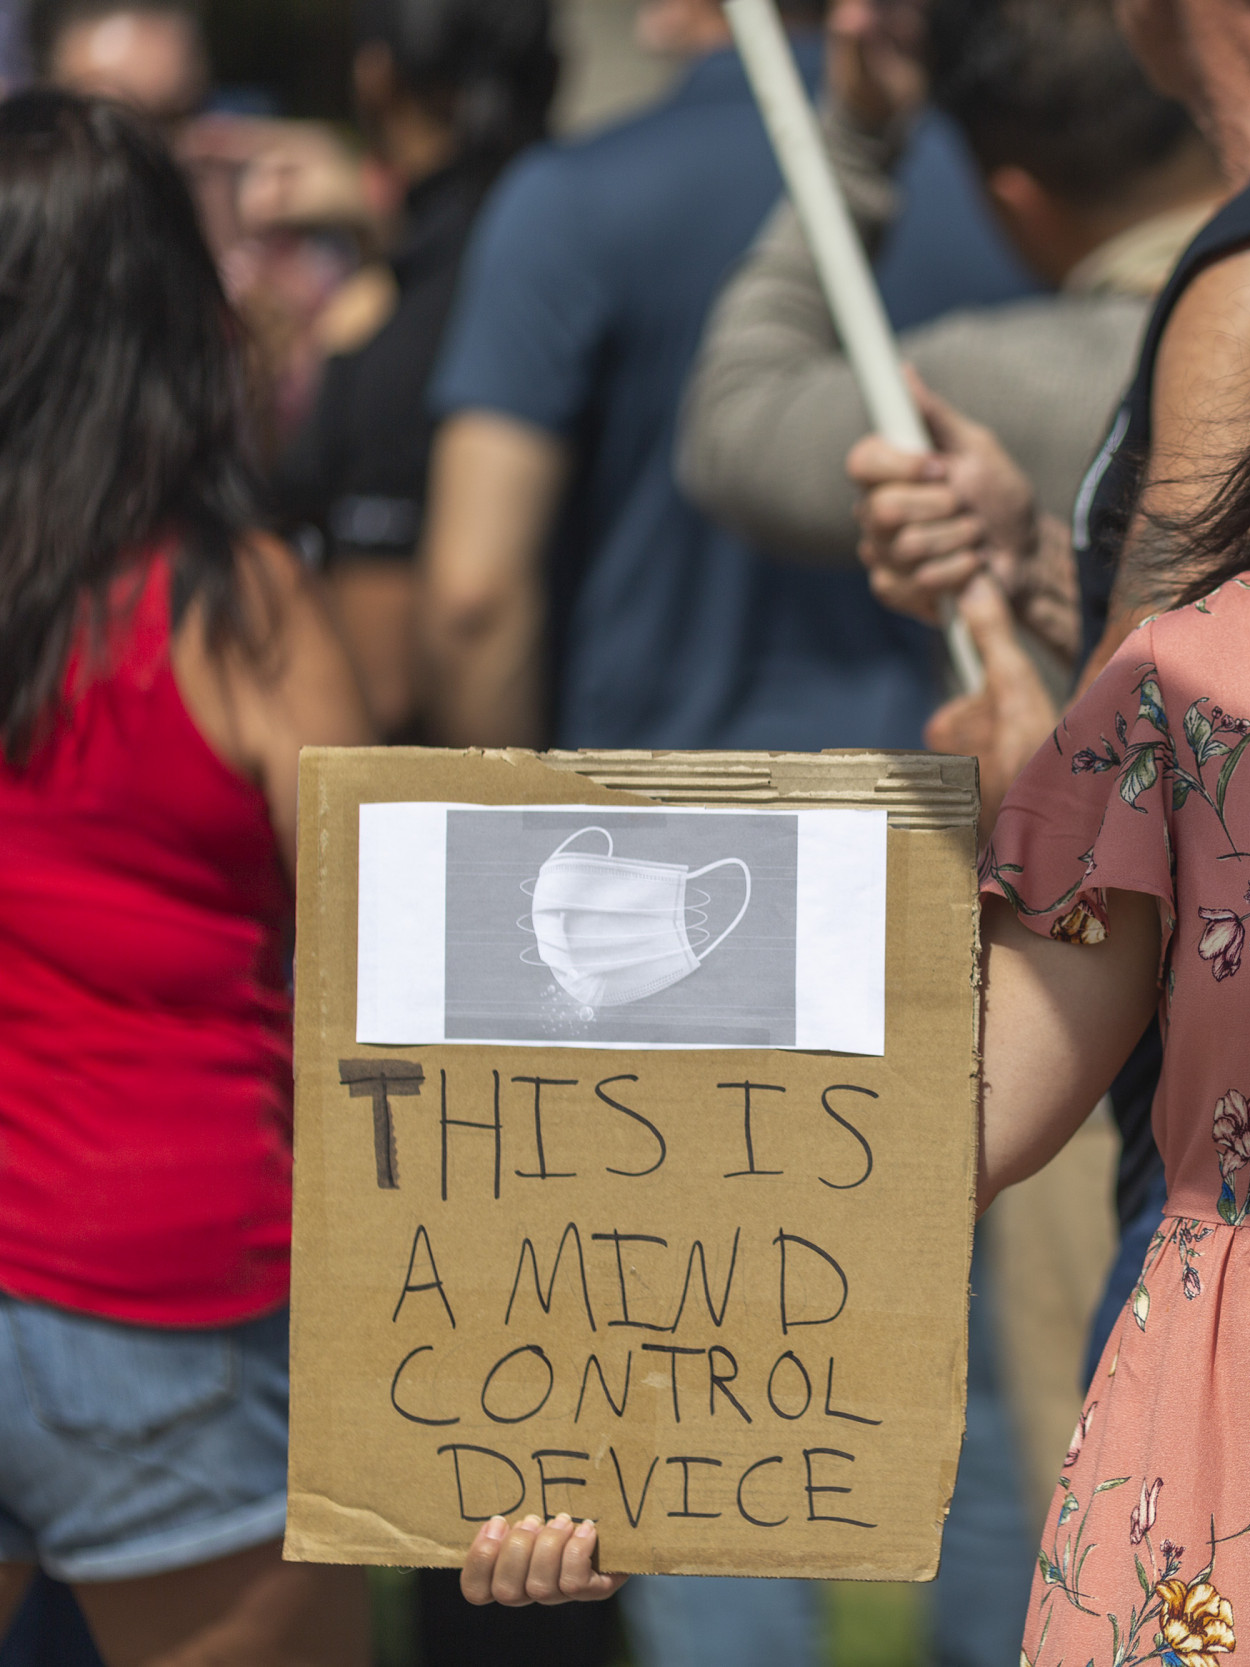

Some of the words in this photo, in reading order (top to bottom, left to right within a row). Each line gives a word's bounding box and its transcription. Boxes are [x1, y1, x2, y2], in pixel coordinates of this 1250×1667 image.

[338, 1058, 667, 1200] THIS
[717, 1080, 879, 1190] IS
[391, 1224, 456, 1329] A
[505, 1221, 849, 1335] MIND
[390, 1344, 884, 1427] CONTROL
[437, 1443, 879, 1529] DEVICE
